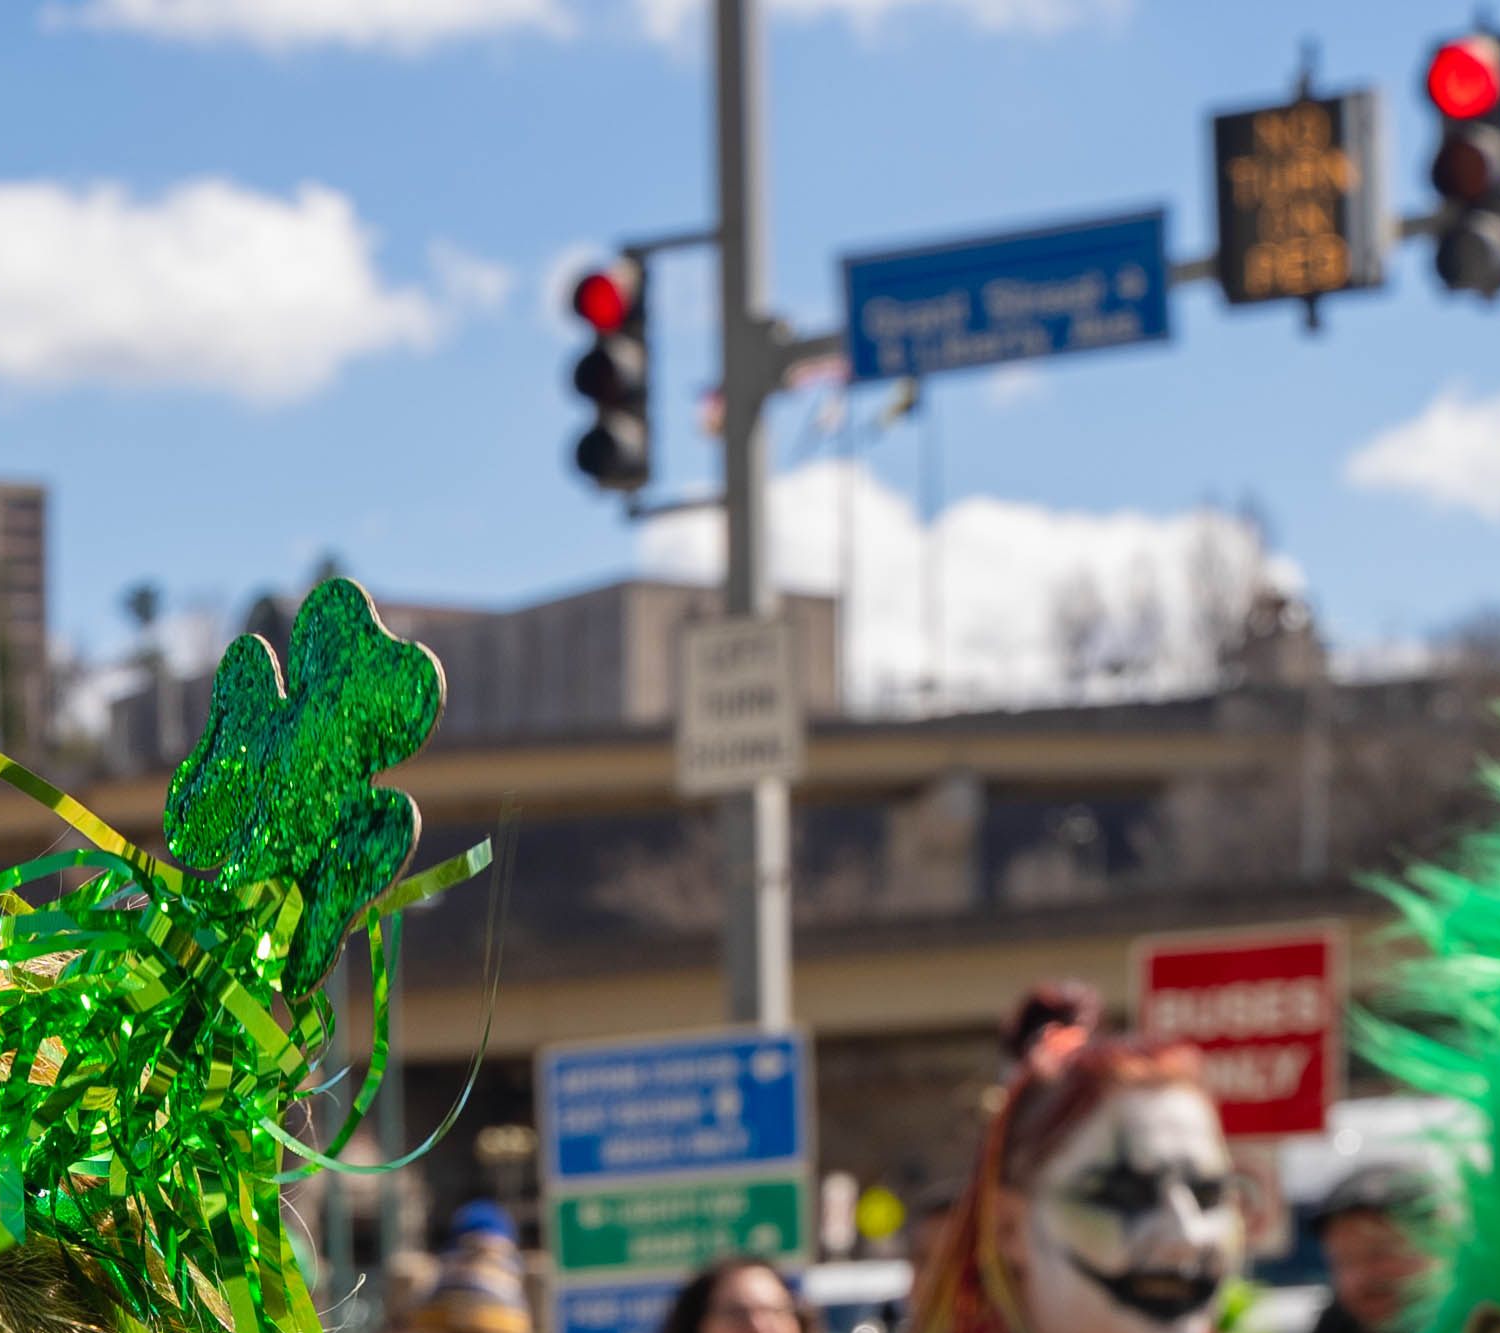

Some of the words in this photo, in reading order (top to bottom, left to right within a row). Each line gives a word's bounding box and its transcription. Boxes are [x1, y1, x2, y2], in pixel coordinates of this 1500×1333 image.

[1254, 106, 1330, 152] NO
[1231, 149, 1358, 203] TURN
[1259, 199, 1333, 245] ON
[1246, 240, 1349, 292] RED
[1150, 977, 1322, 1041] BUSES
